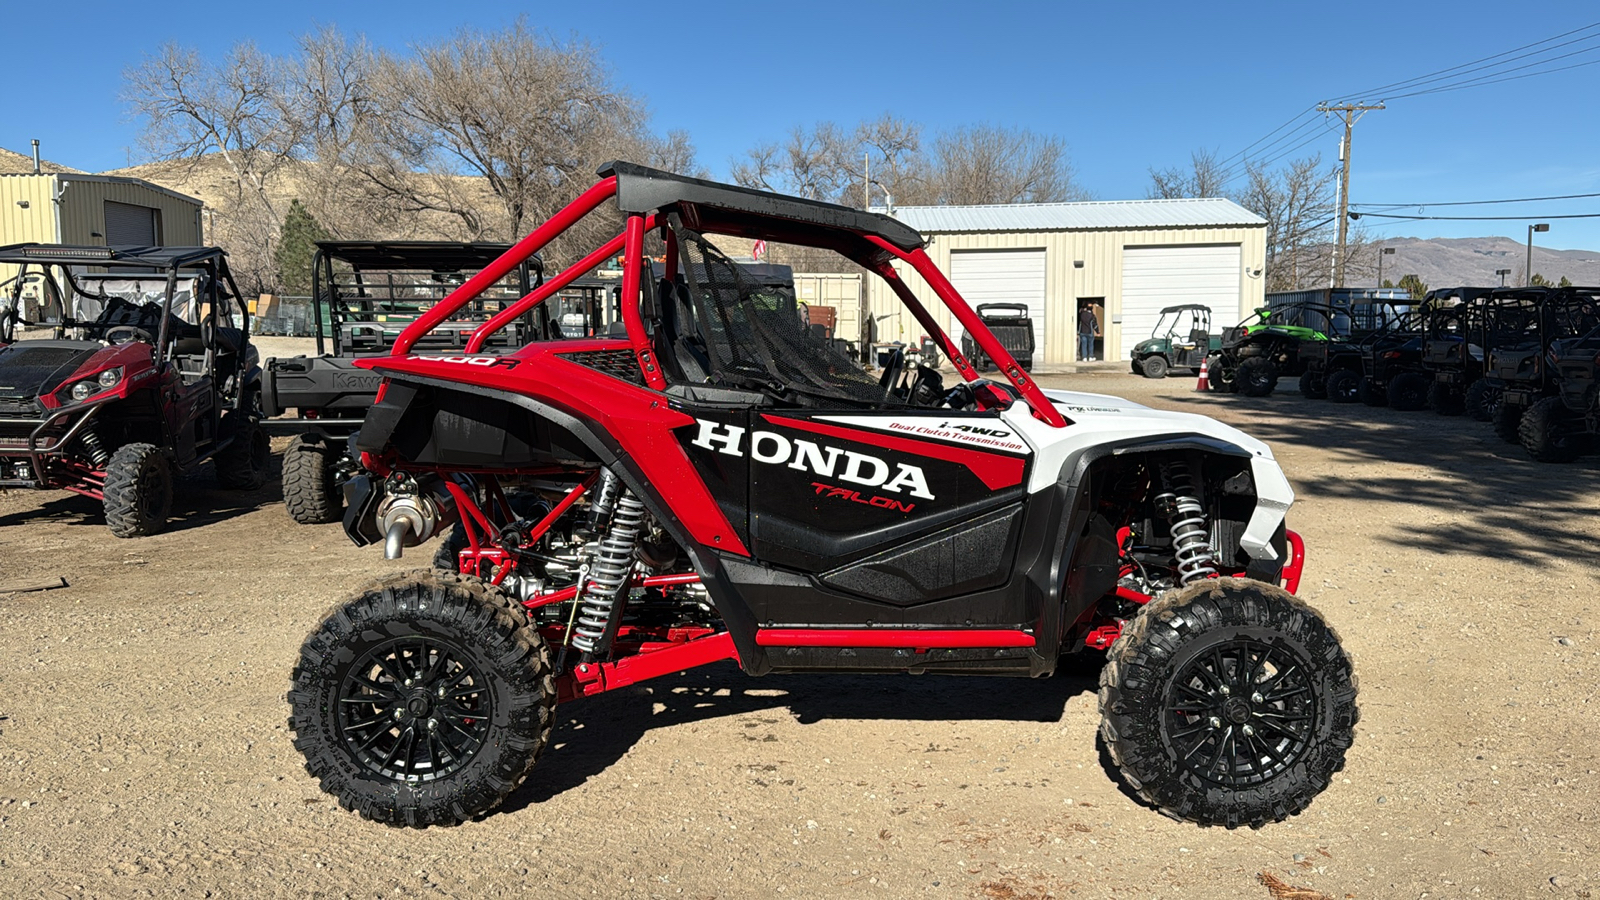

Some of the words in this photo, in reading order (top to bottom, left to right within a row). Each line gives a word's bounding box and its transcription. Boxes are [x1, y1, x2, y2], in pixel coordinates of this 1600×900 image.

[889, 422, 913, 432] Dual
[916, 426, 950, 438] Clutch
[952, 432, 1022, 450] Transmission
[692, 418, 935, 500] HONDA
[811, 482, 915, 513] TALON
